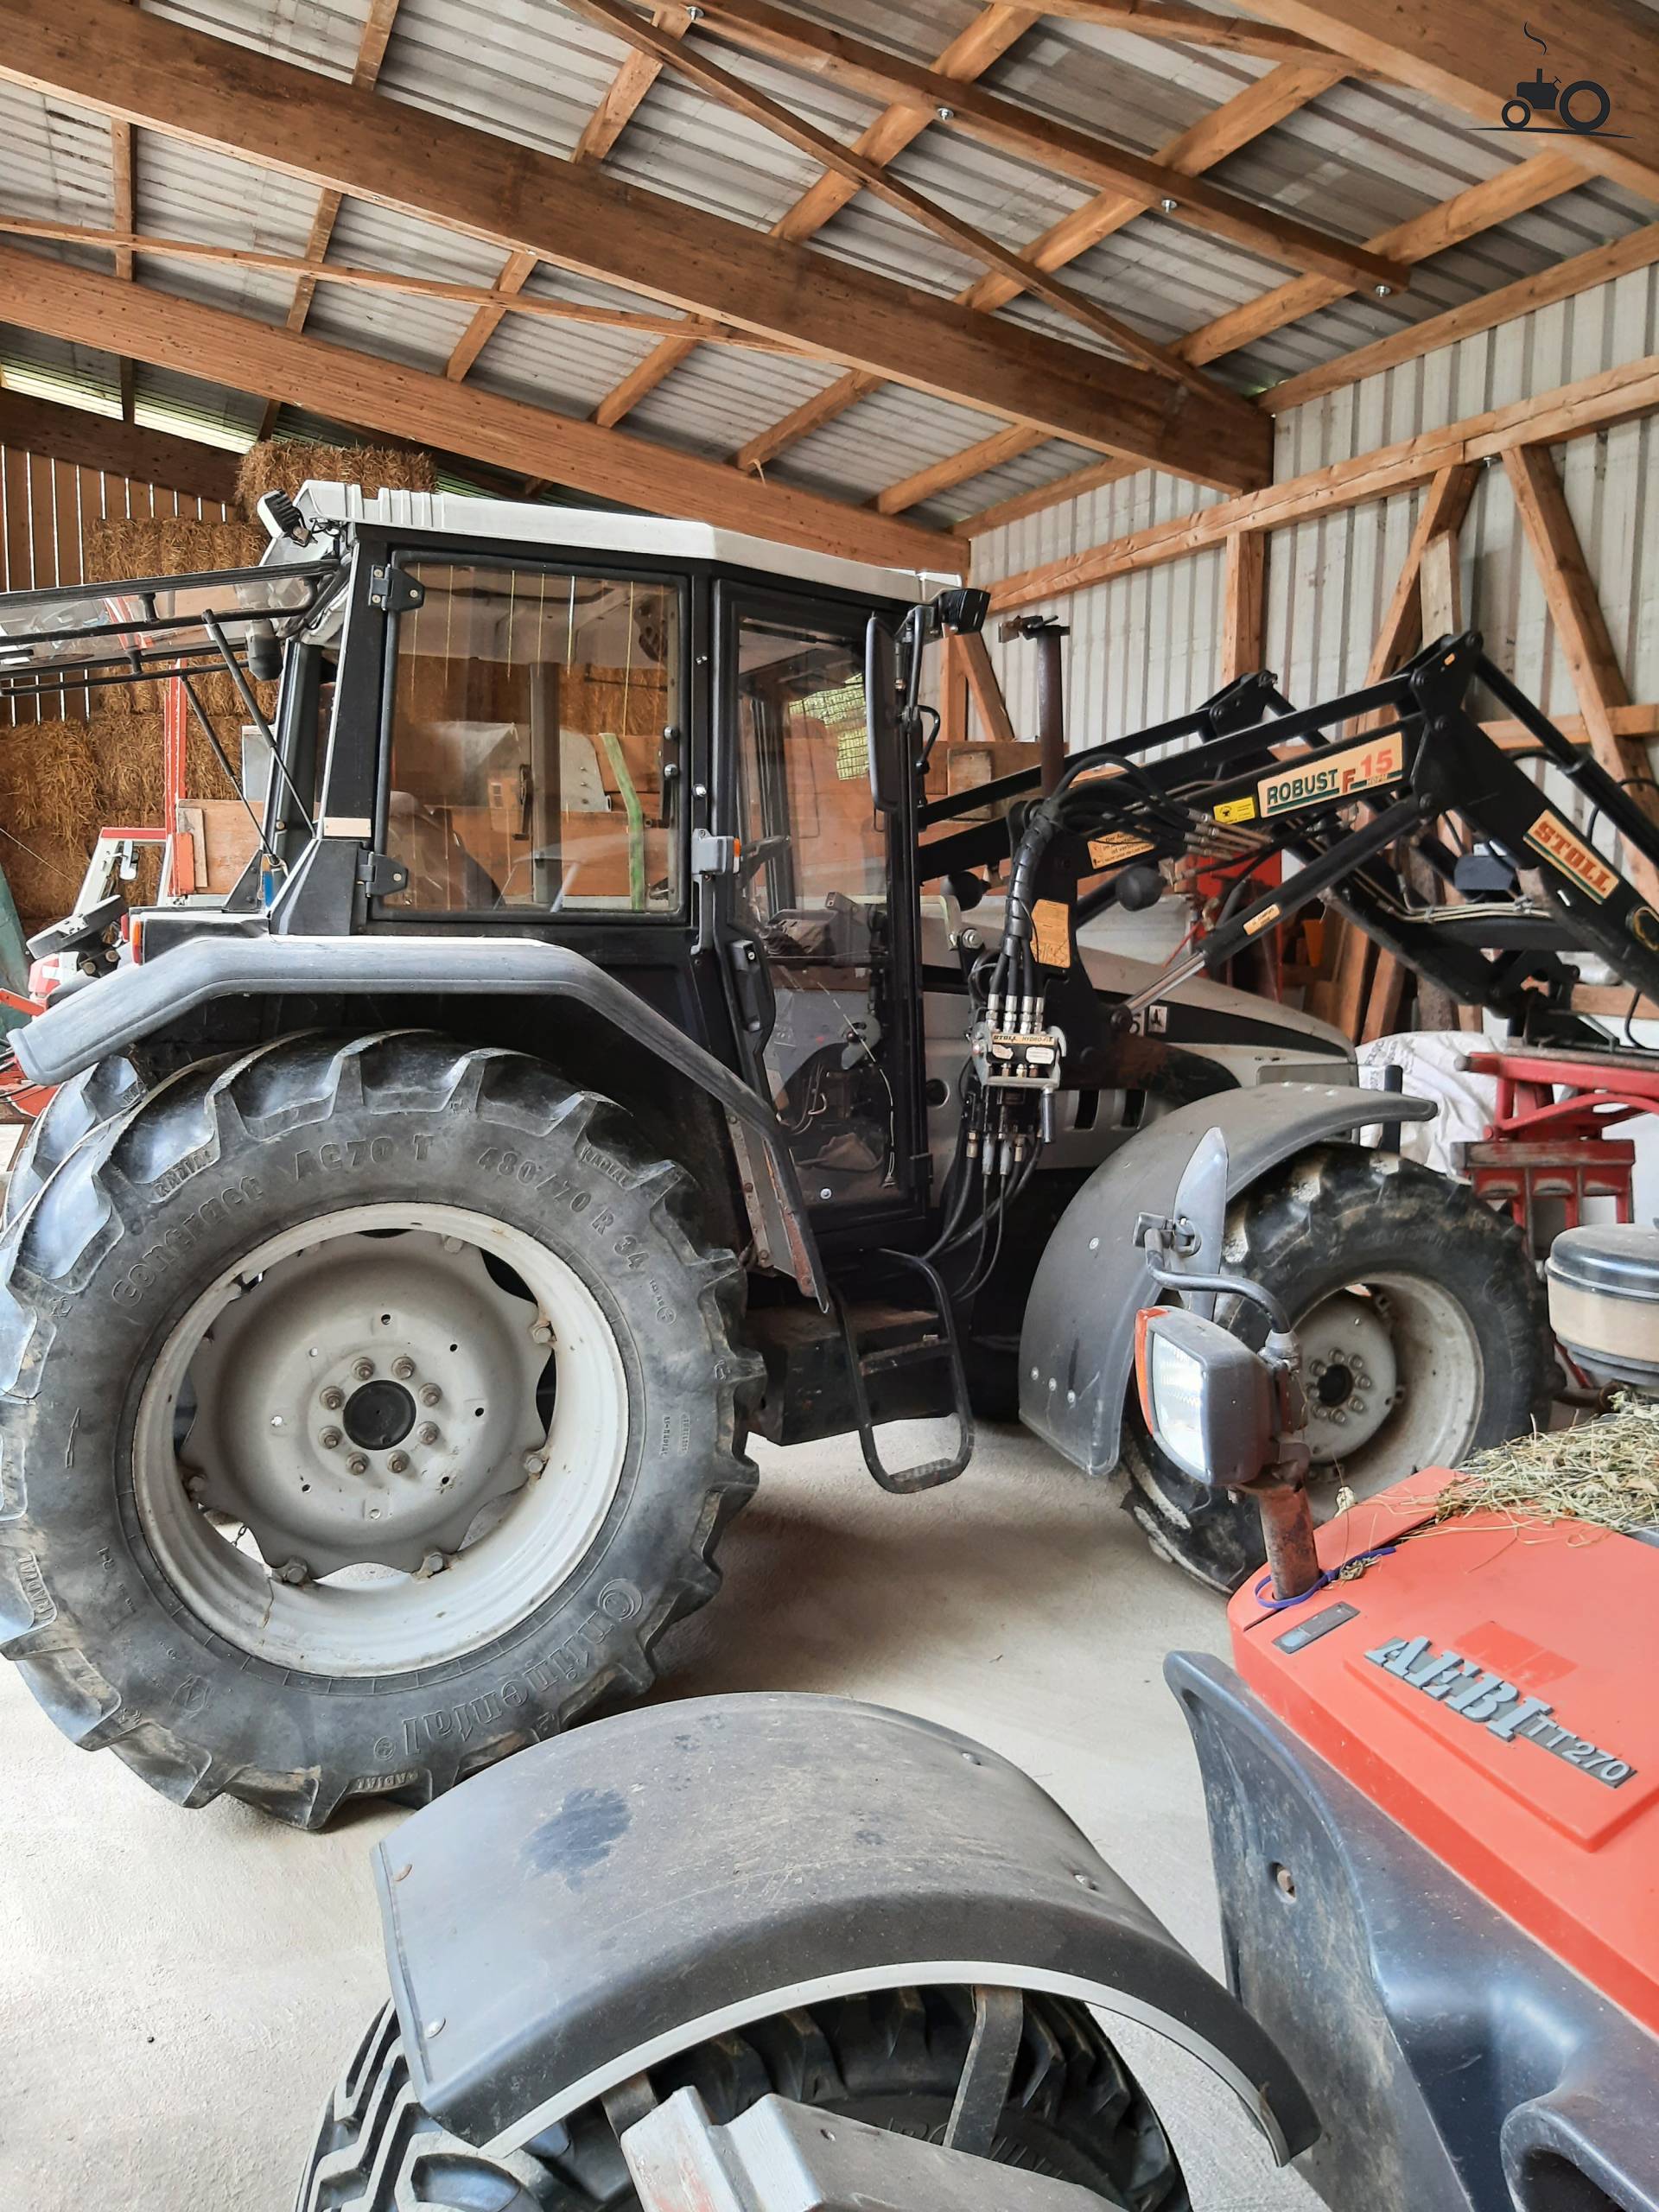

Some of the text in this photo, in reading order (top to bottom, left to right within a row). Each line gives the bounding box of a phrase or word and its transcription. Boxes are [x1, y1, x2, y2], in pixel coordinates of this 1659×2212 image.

[1267, 768, 1338, 806] ROBUST
[1342, 768, 1357, 794] F
[1360, 748, 1395, 779] 15
[1533, 820, 1610, 893] STOLL
[590, 1208, 615, 1236] R
[613, 1235, 650, 1270] 34
[402, 1578, 644, 1757] Continental
[1363, 1636, 1554, 1743] AEBI
